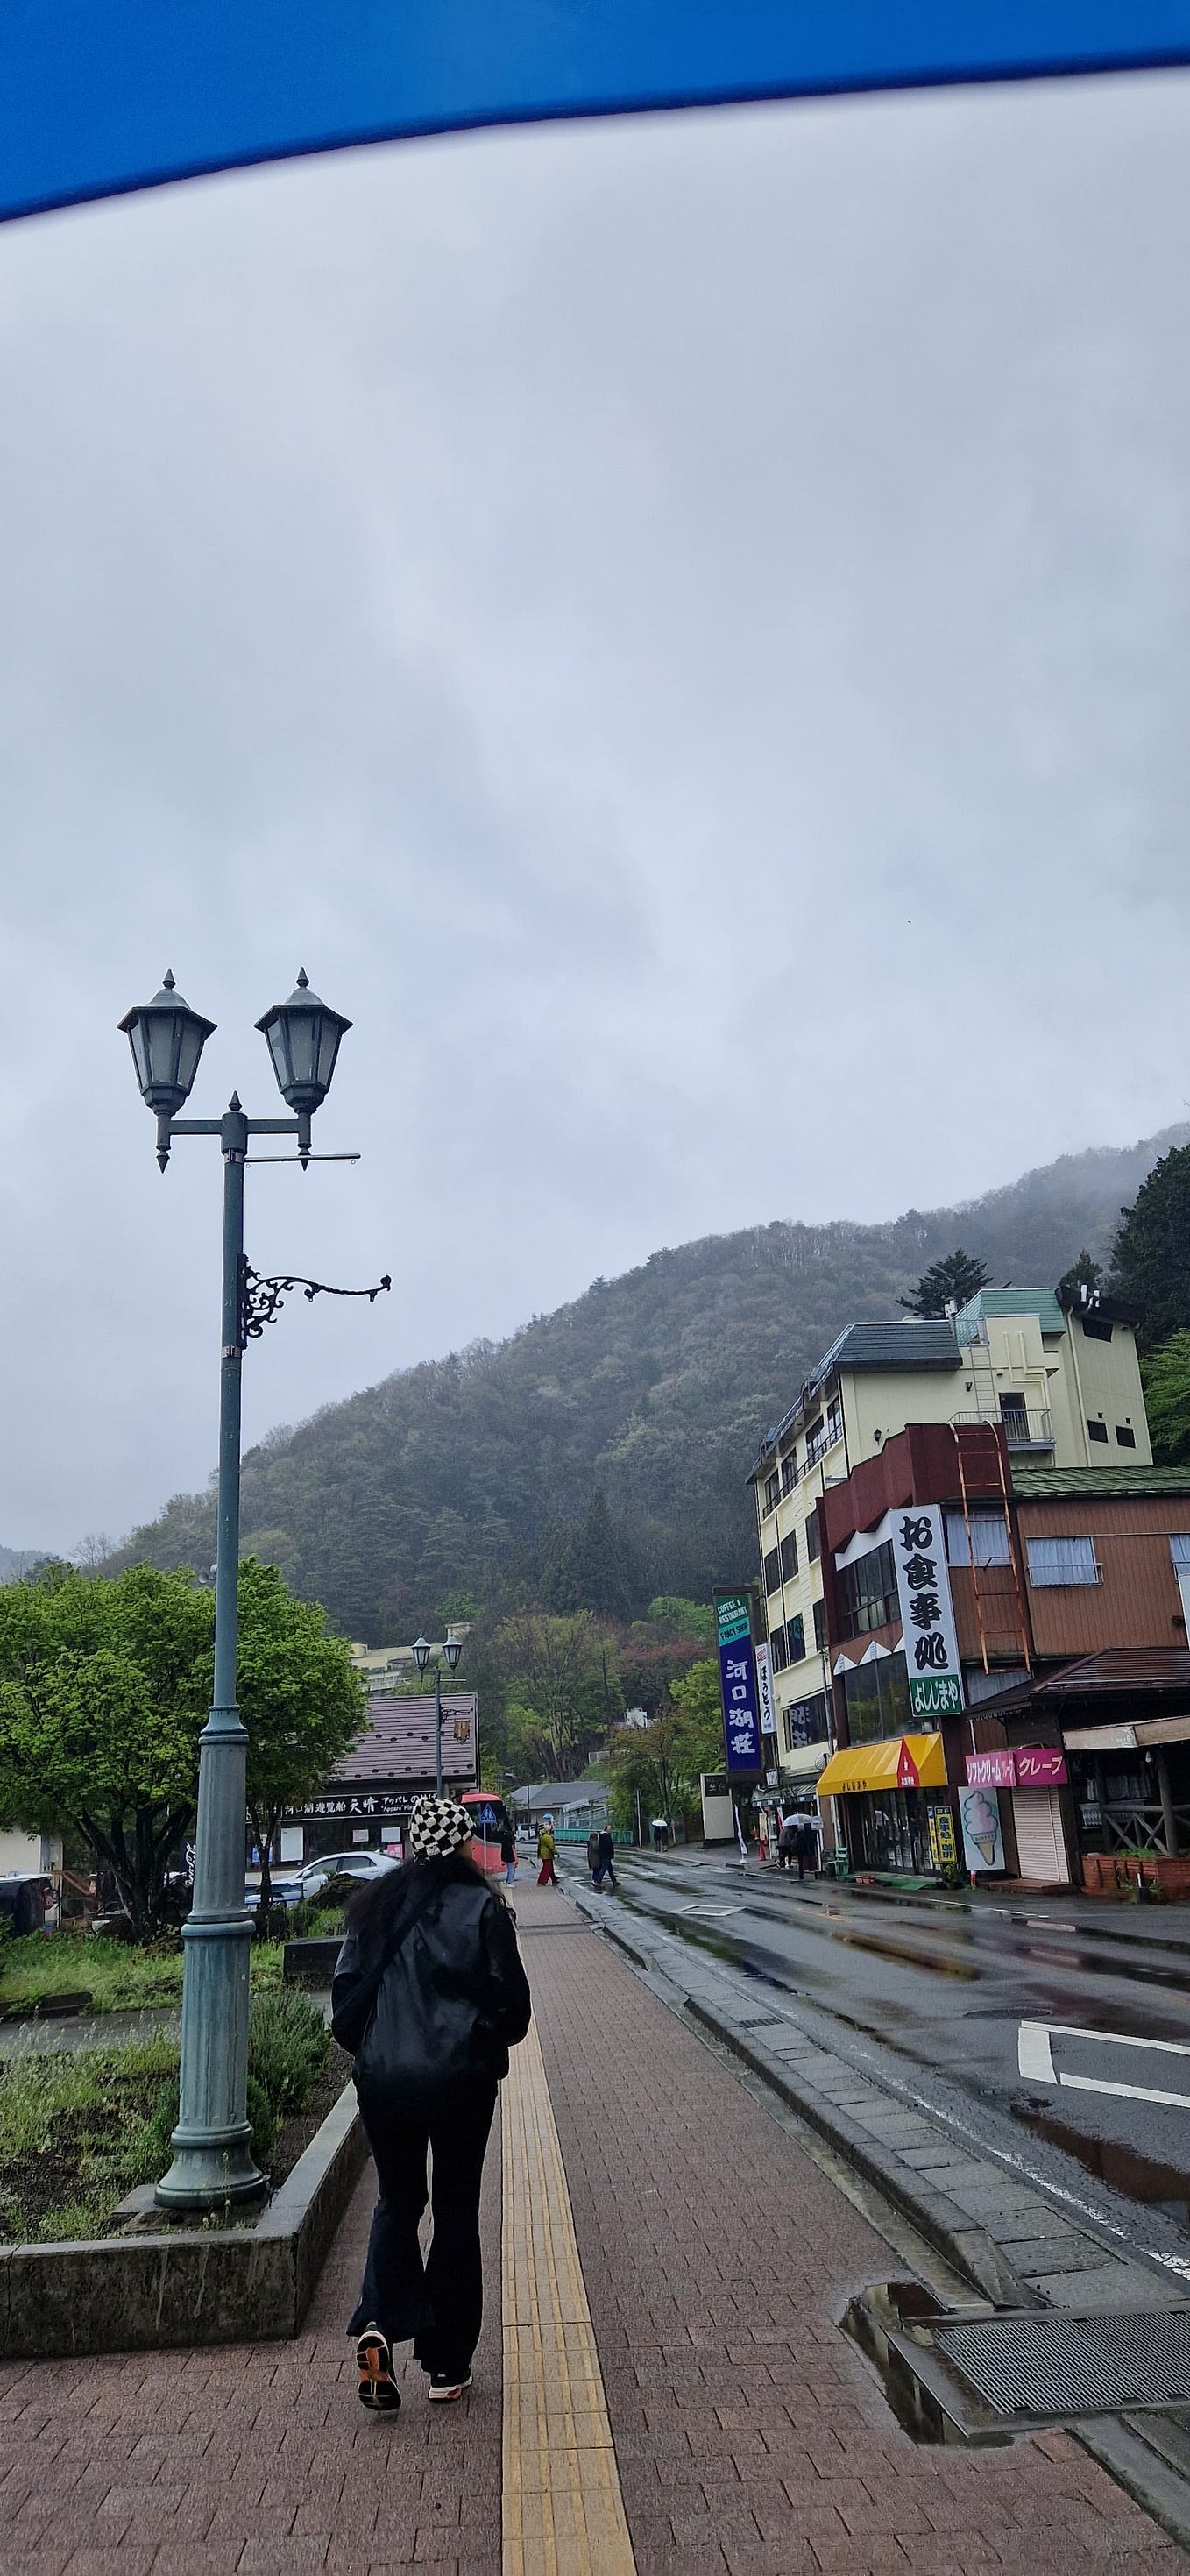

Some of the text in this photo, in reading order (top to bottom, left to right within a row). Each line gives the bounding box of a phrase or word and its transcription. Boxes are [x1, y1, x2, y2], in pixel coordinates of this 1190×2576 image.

[899, 1515, 949, 1671] お食事処
[718, 1600, 737, 1614] COFFEE
[719, 1607, 747, 1624] RESTAURANT
[720, 1622, 748, 1641] FANCY SHOP
[726, 1659, 756, 1754] 河口湖荘
[760, 1665, 771, 1721] ほうとう
[914, 1680, 959, 1714] よしじまや
[967, 1758, 1002, 1785] ソフトクリーム
[1019, 1756, 1063, 1777] クレープ
